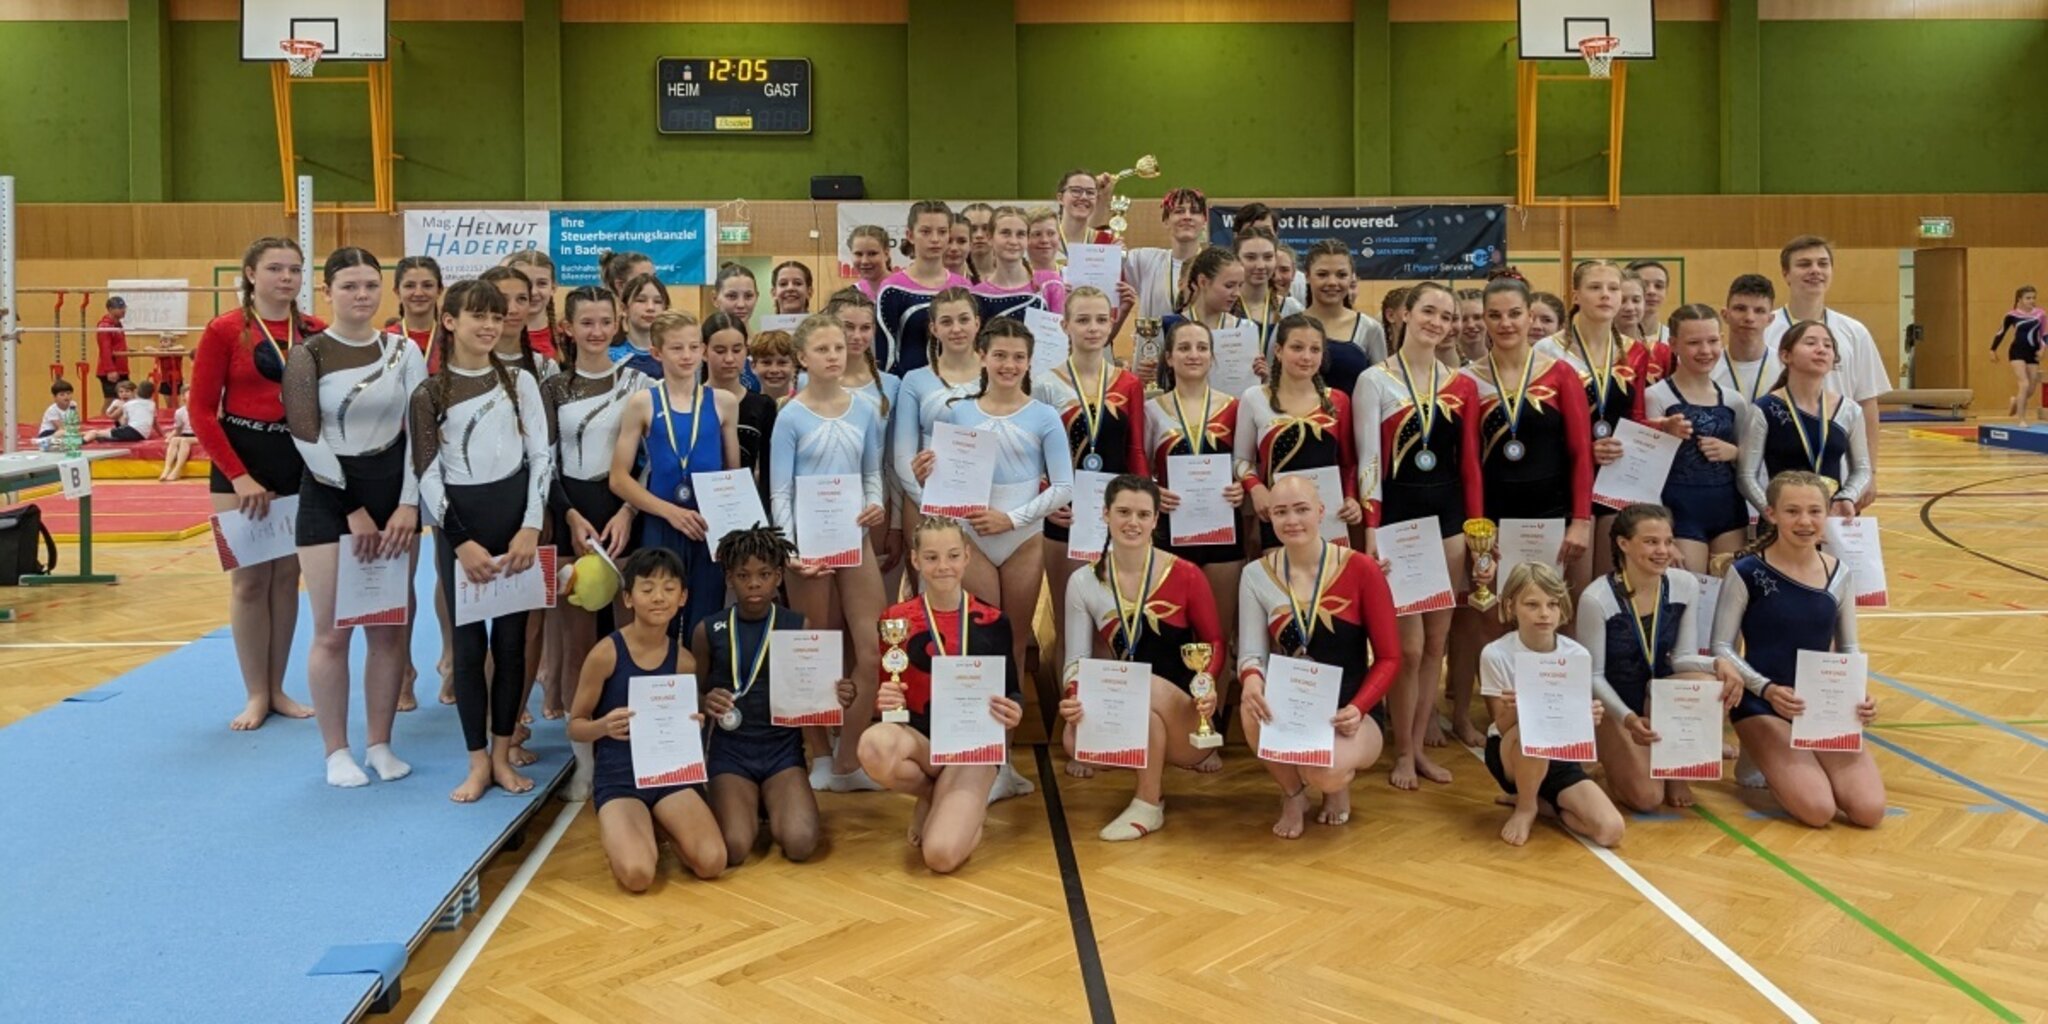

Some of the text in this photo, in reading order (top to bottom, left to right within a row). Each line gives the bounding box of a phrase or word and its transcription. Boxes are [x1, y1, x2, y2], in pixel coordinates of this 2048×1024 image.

[708, 59, 768, 81] 12:05
[667, 83, 700, 97] HEIM
[764, 83, 799, 97] GAST
[422, 216, 538, 237] Mag. HELMUT
[561, 217, 585, 228] Ihre
[1278, 214, 1399, 229] ot it all covered.
[561, 230, 697, 243] Steuerberatungskanzlei
[424, 233, 538, 257] HADERER
[1440, 263, 1474, 272] Services
[226, 416, 291, 433] NIKE PR
[71, 467, 81, 488] B
